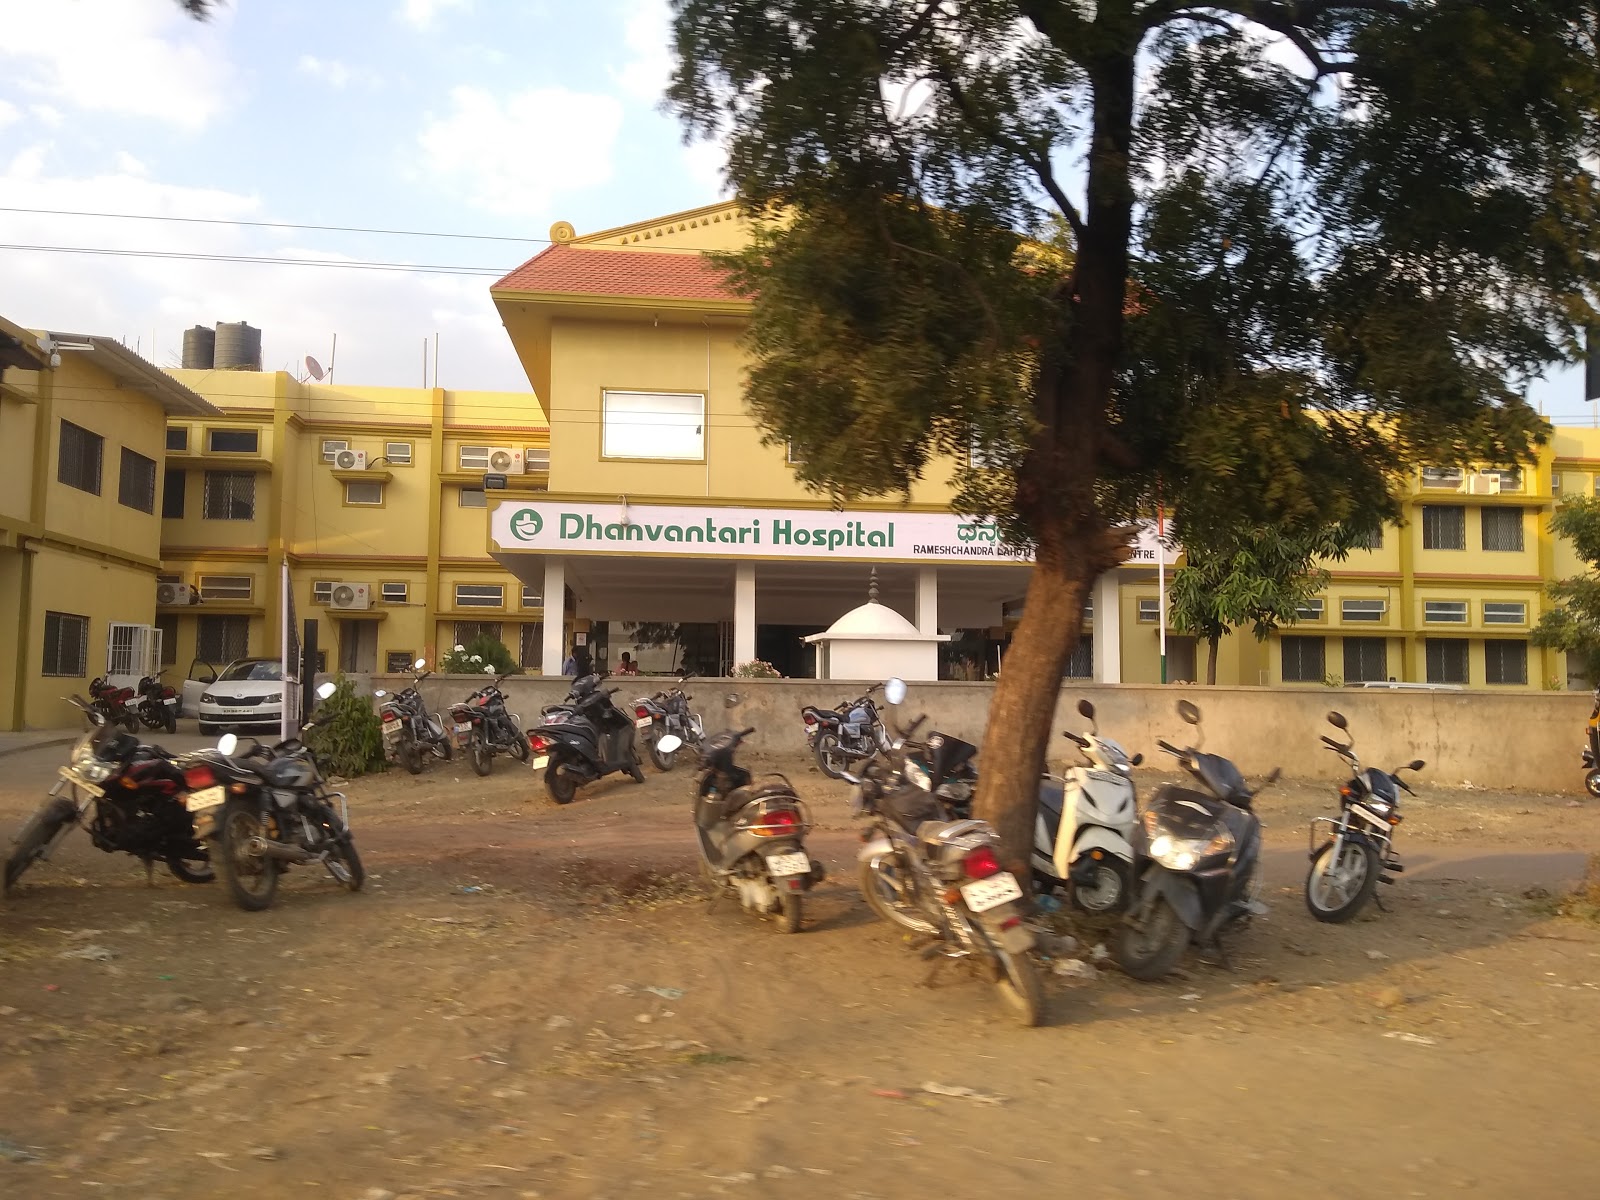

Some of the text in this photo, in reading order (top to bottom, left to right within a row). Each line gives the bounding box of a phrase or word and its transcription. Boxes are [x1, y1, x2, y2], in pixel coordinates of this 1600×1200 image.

[560, 513, 894, 551] Dhanvantari Hospital
[913, 544, 994, 556] RAMESHCHANDRA
[1130, 549, 1155, 559] NTRE
